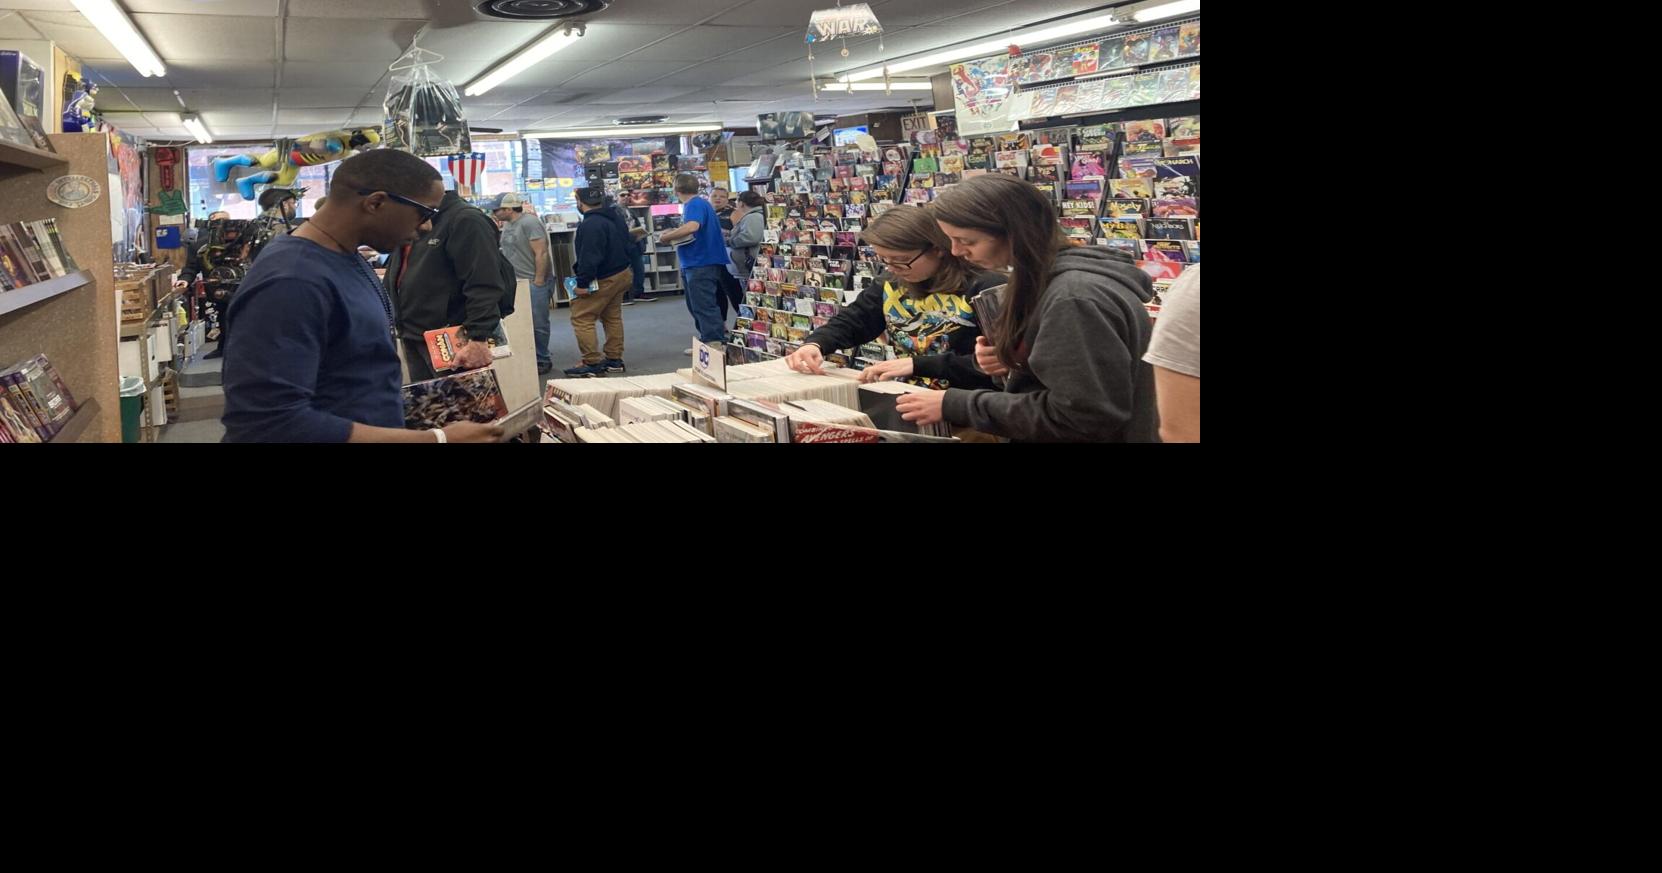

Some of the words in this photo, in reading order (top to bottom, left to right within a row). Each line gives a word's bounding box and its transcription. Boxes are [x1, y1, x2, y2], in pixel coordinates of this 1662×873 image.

[903, 116, 927, 131] EXIT
[1062, 201, 1075, 209] HEY
[882, 281, 974, 320] X-MEN
[435, 333, 450, 362] CONAN
[800, 428, 855, 443] AVENGERS
